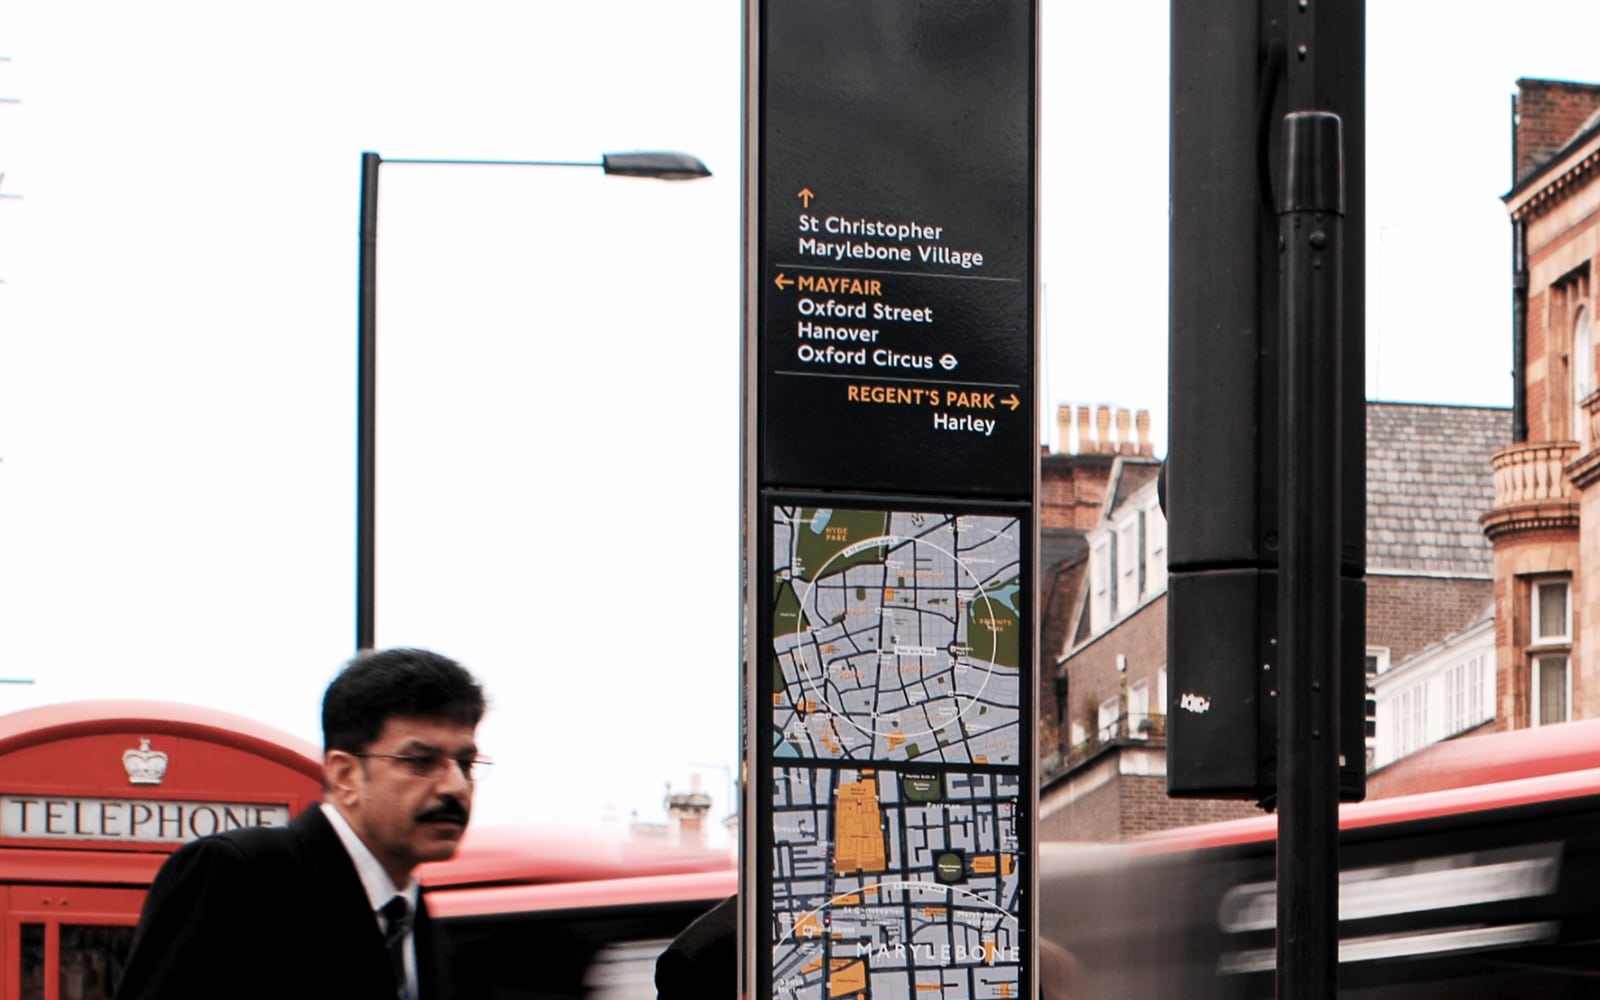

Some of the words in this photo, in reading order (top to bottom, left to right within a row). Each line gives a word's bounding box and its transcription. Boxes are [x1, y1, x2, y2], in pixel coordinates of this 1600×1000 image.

[799, 215, 819, 232] St
[825, 217, 942, 240] Christopher
[799, 238, 912, 262] Marylebone
[918, 245, 983, 268] Village
[798, 276, 882, 296] MAYFAIR
[798, 299, 866, 319] Oxford
[873, 303, 933, 322] Street
[798, 322, 879, 342] Hanover
[798, 345, 866, 365] Oxford
[873, 350, 933, 368] Circus
[848, 386, 939, 406] REGENT'S
[947, 392, 995, 409] PARK
[934, 413, 996, 436] Harley
[9, 800, 277, 838] TELEPHONE
[856, 942, 1020, 962] MARYLEBONE
